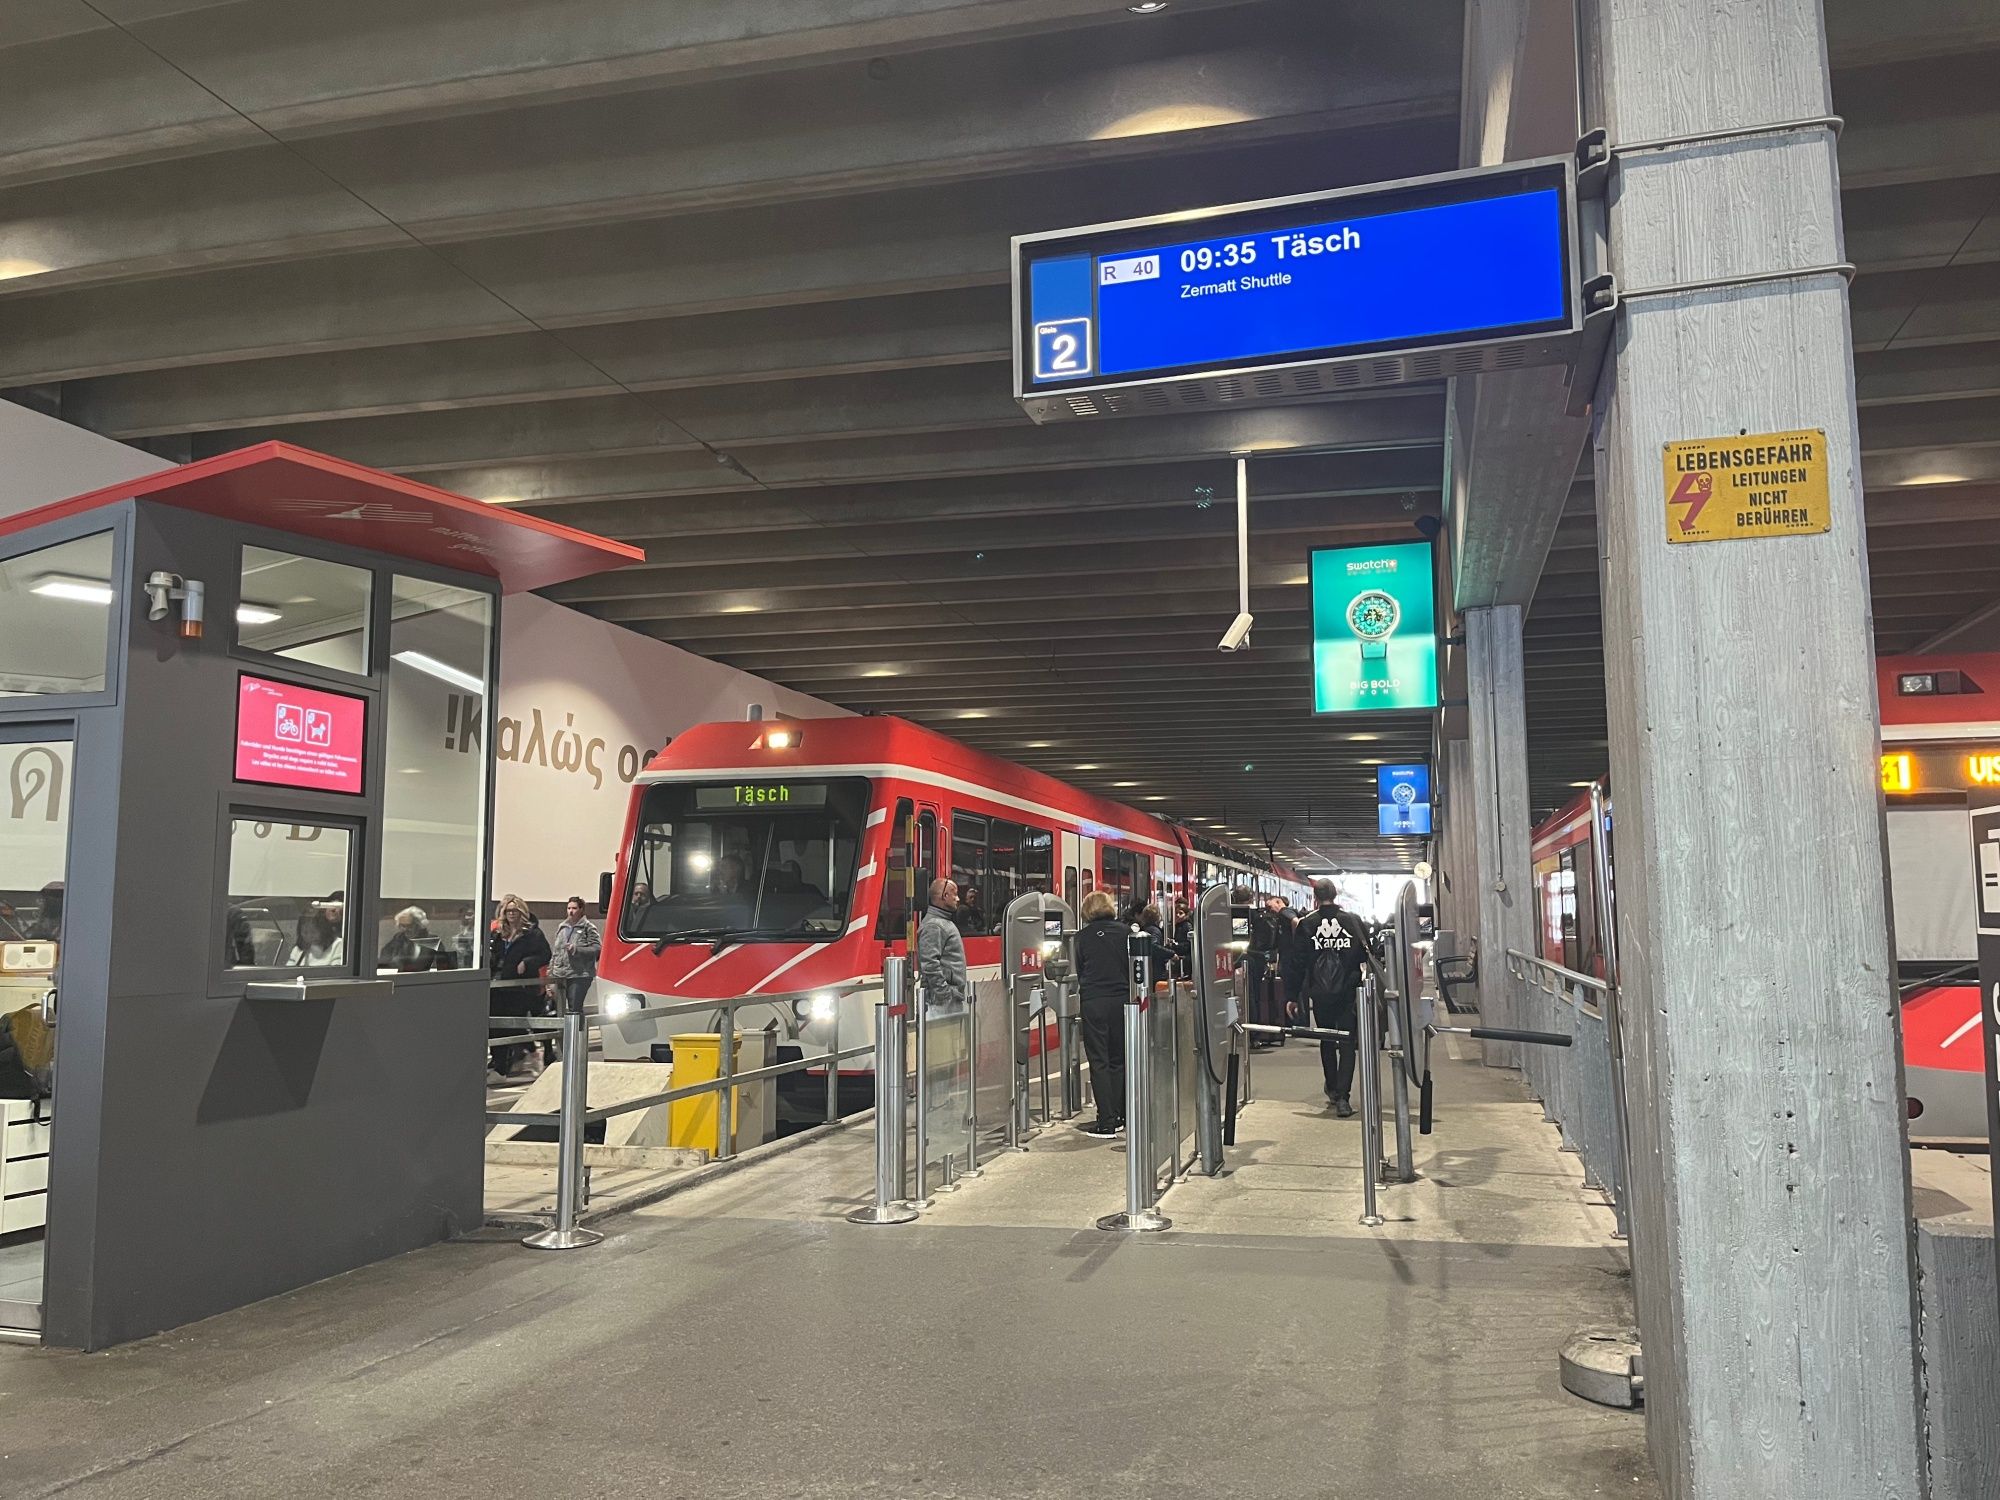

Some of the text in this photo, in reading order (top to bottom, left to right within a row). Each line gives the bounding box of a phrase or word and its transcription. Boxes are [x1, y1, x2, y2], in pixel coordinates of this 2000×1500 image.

[1104, 227, 1361, 280] R 40 09:35 Täsch
[1180, 272, 1292, 298] Zermatt Shuttle
[1052, 334, 1077, 370] 2
[1676, 443, 1813, 472] LEBENSGEFAHR
[1732, 468, 1807, 488] LEITUNGEN
[1749, 490, 1788, 507] NICHT
[1737, 507, 1808, 527] BERÜHREN
[1346, 559, 1390, 571] swatch
[1370, 679, 1401, 689] BOLD
[734, 785, 789, 802] Täsch
